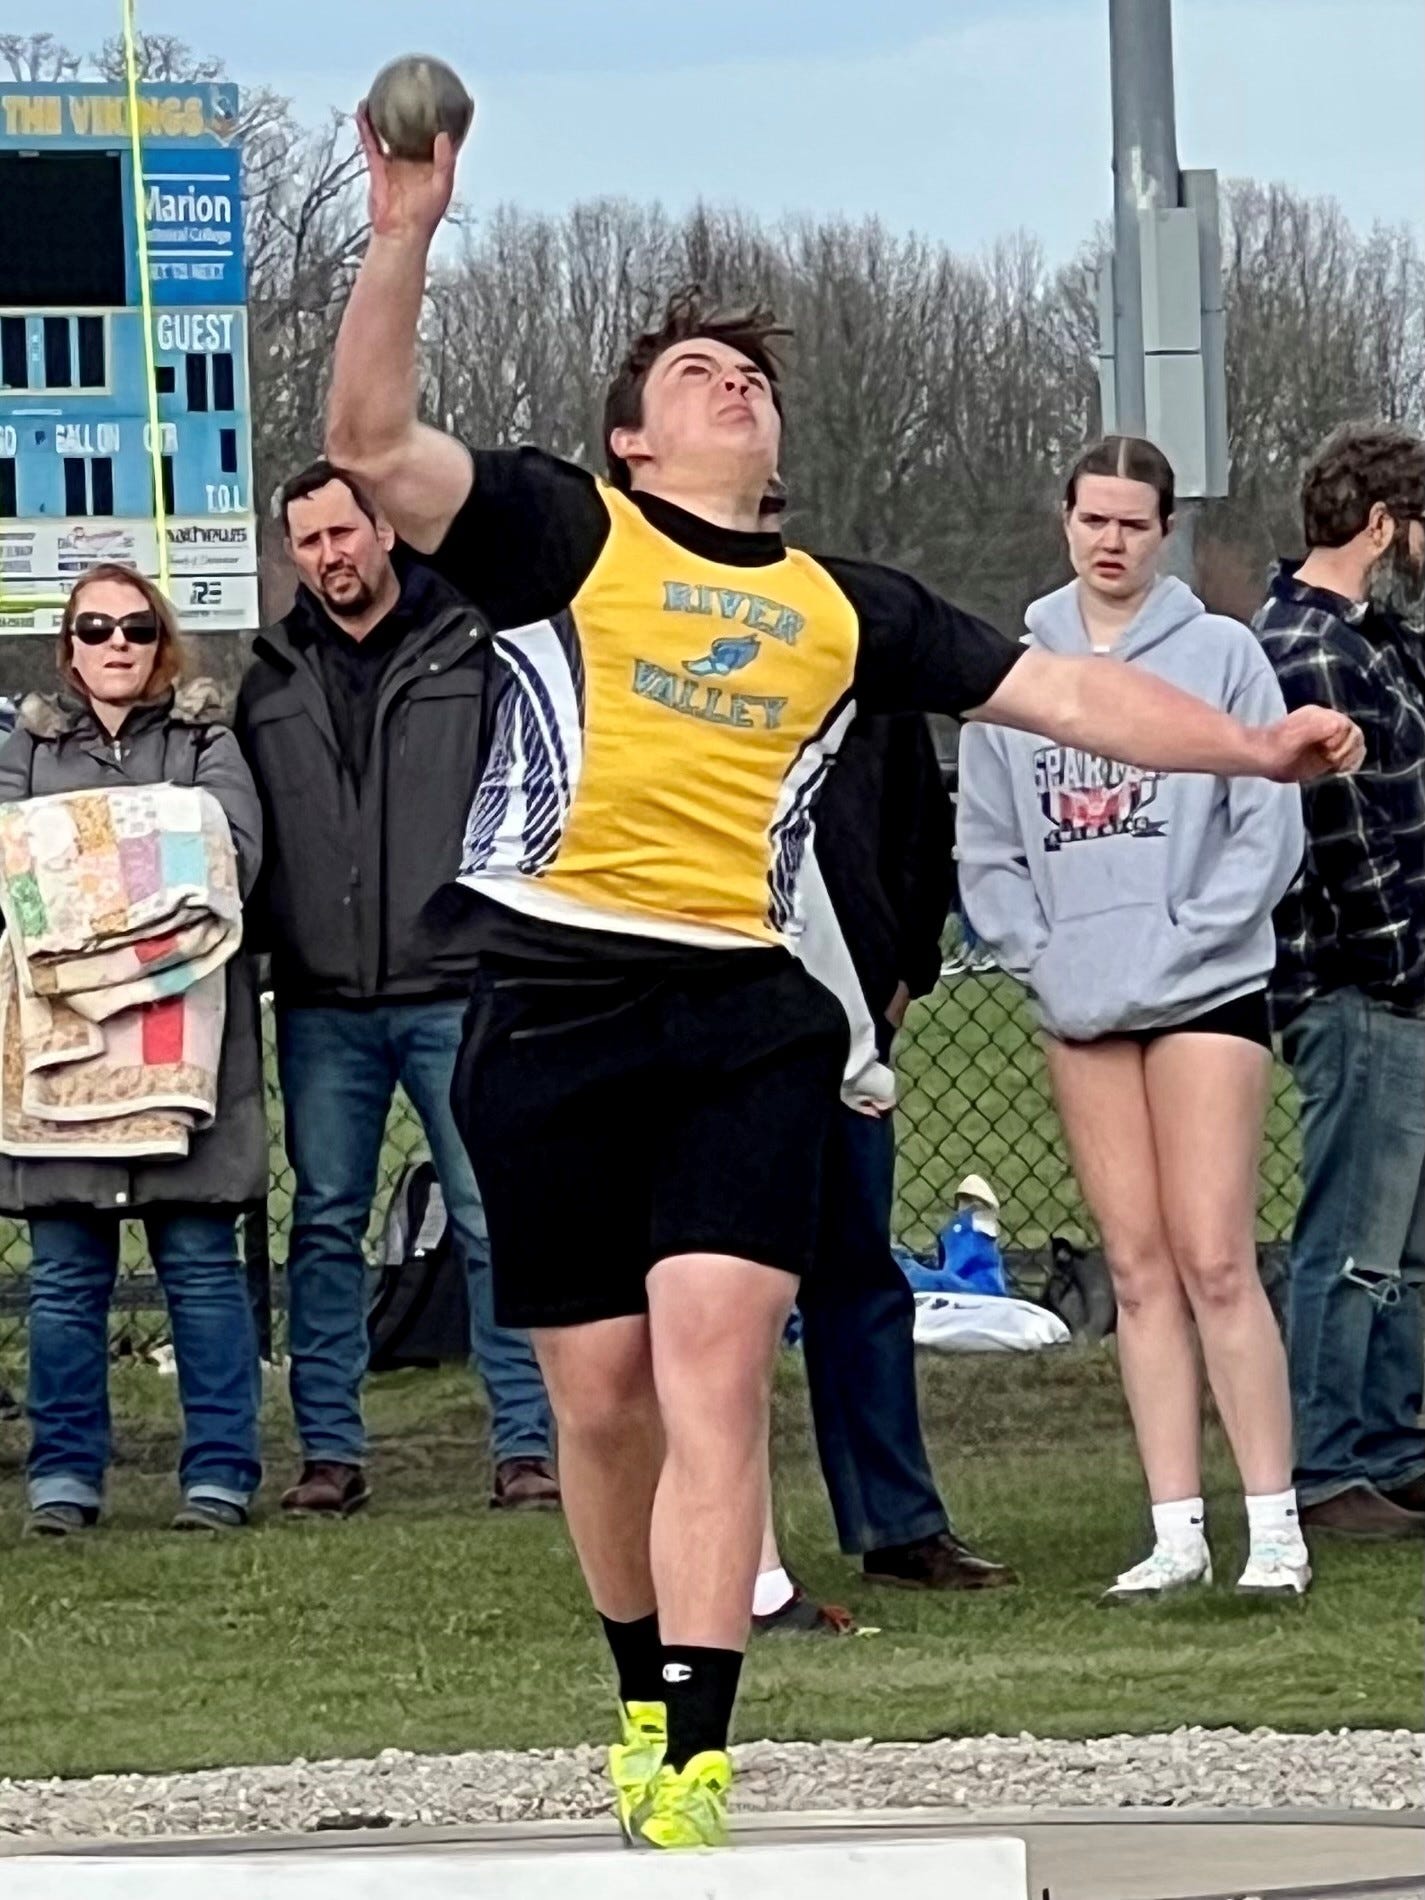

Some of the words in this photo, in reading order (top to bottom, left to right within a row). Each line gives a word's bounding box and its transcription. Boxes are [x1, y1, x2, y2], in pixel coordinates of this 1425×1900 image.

[69, 95, 205, 137] VIKNGS
[157, 314, 233, 350] GUEST
[662, 580, 805, 647] RIVER
[632, 658, 789, 729] VALLEY
